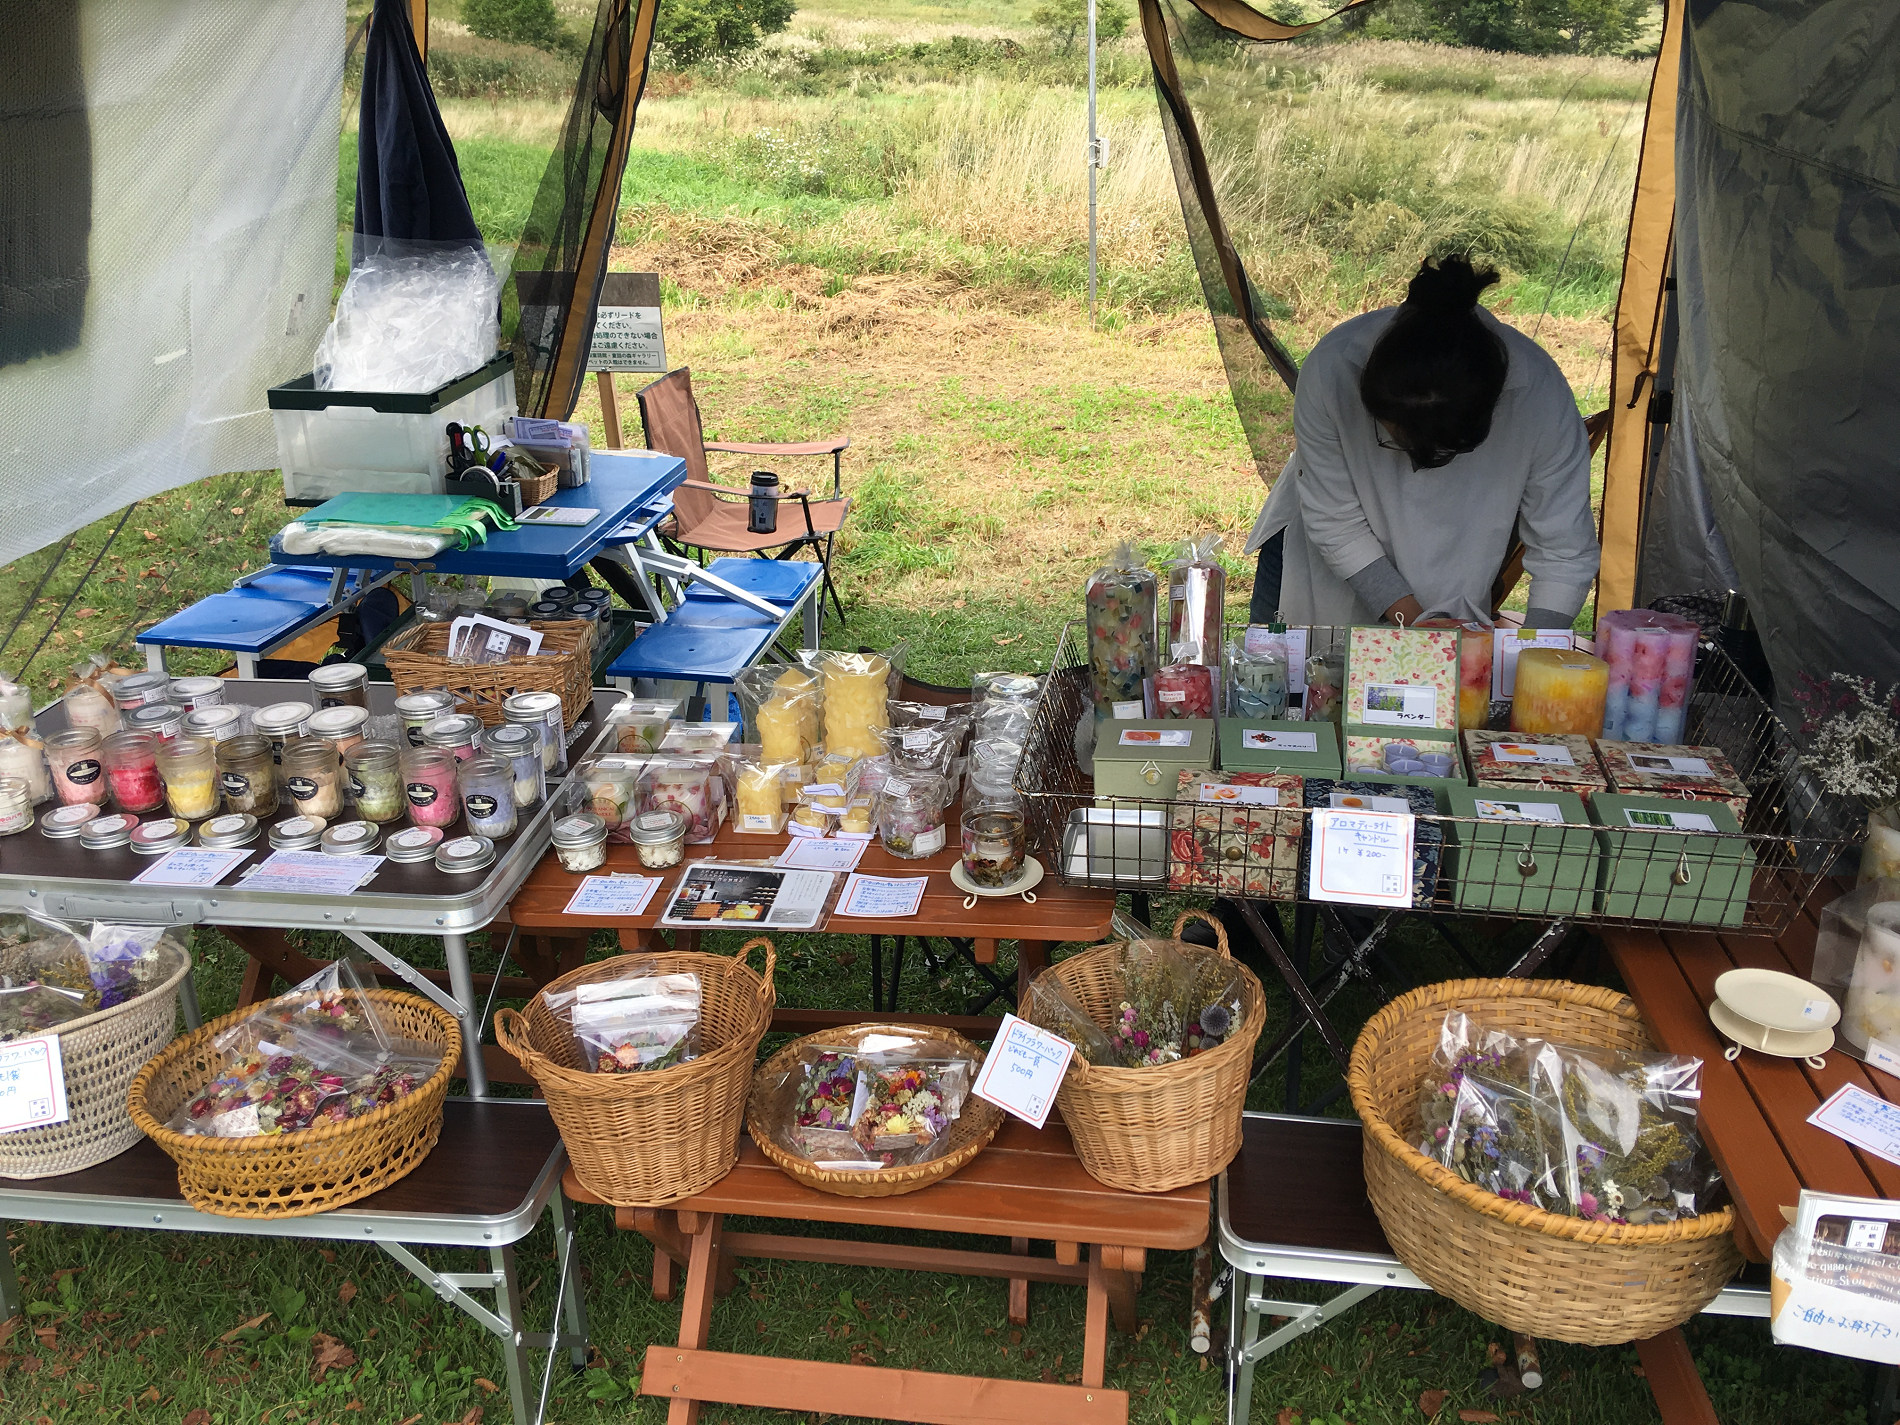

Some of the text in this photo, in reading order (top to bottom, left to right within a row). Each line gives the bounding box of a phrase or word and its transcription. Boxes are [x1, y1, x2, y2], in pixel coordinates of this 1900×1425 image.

[593, 332, 658, 340] 処理のできない場合
[1396, 713, 1431, 721] ラベンダー
[1330, 817, 1393, 832] アロマティーライト
[1354, 831, 1390, 843] キャンドル
[1011, 1027, 1063, 1060] ドライフラワーパック
[1010, 1062, 1034, 1080] 500円
